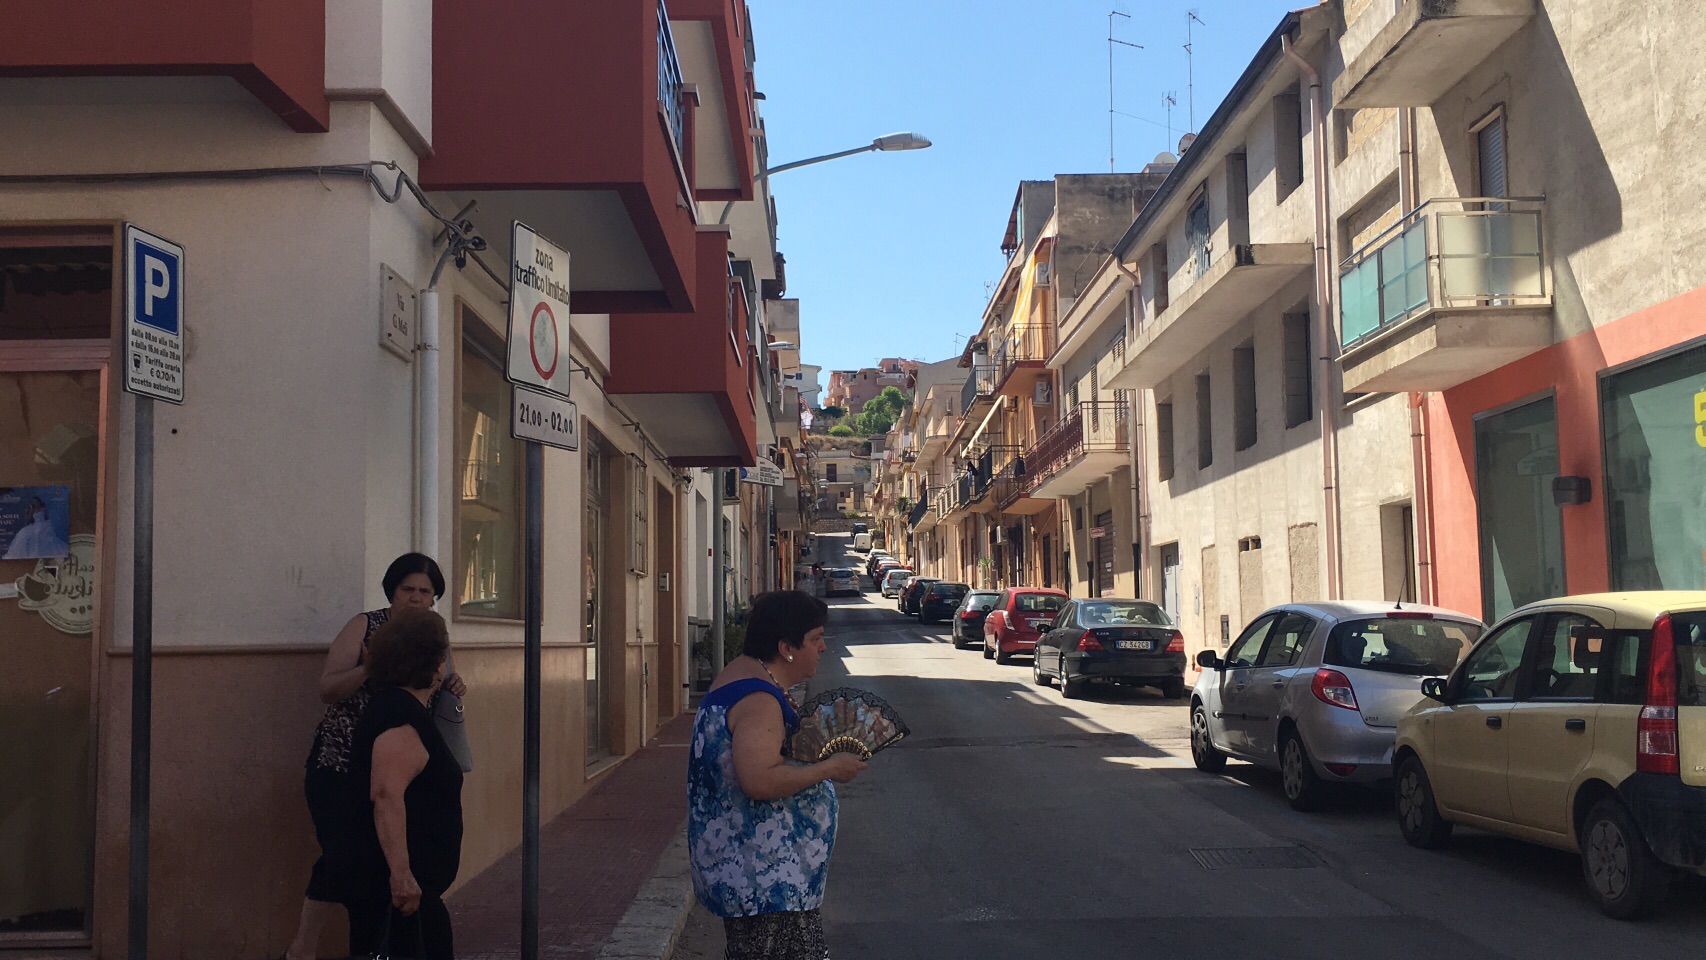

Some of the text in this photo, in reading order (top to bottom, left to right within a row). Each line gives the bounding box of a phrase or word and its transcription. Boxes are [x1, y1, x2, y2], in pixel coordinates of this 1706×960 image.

[535, 248, 554, 273] zona
[145, 254, 170, 316] P
[515, 259, 569, 306] traffico limitato
[131, 327, 144, 338] dalle
[158, 337, 168, 347] alle
[135, 340, 147, 351] dalle
[160, 348, 169, 358] alle
[145, 355, 181, 374] Tariffa oraria
[150, 367, 154, 377] €
[131, 376, 181, 396] eccetto autorizzati
